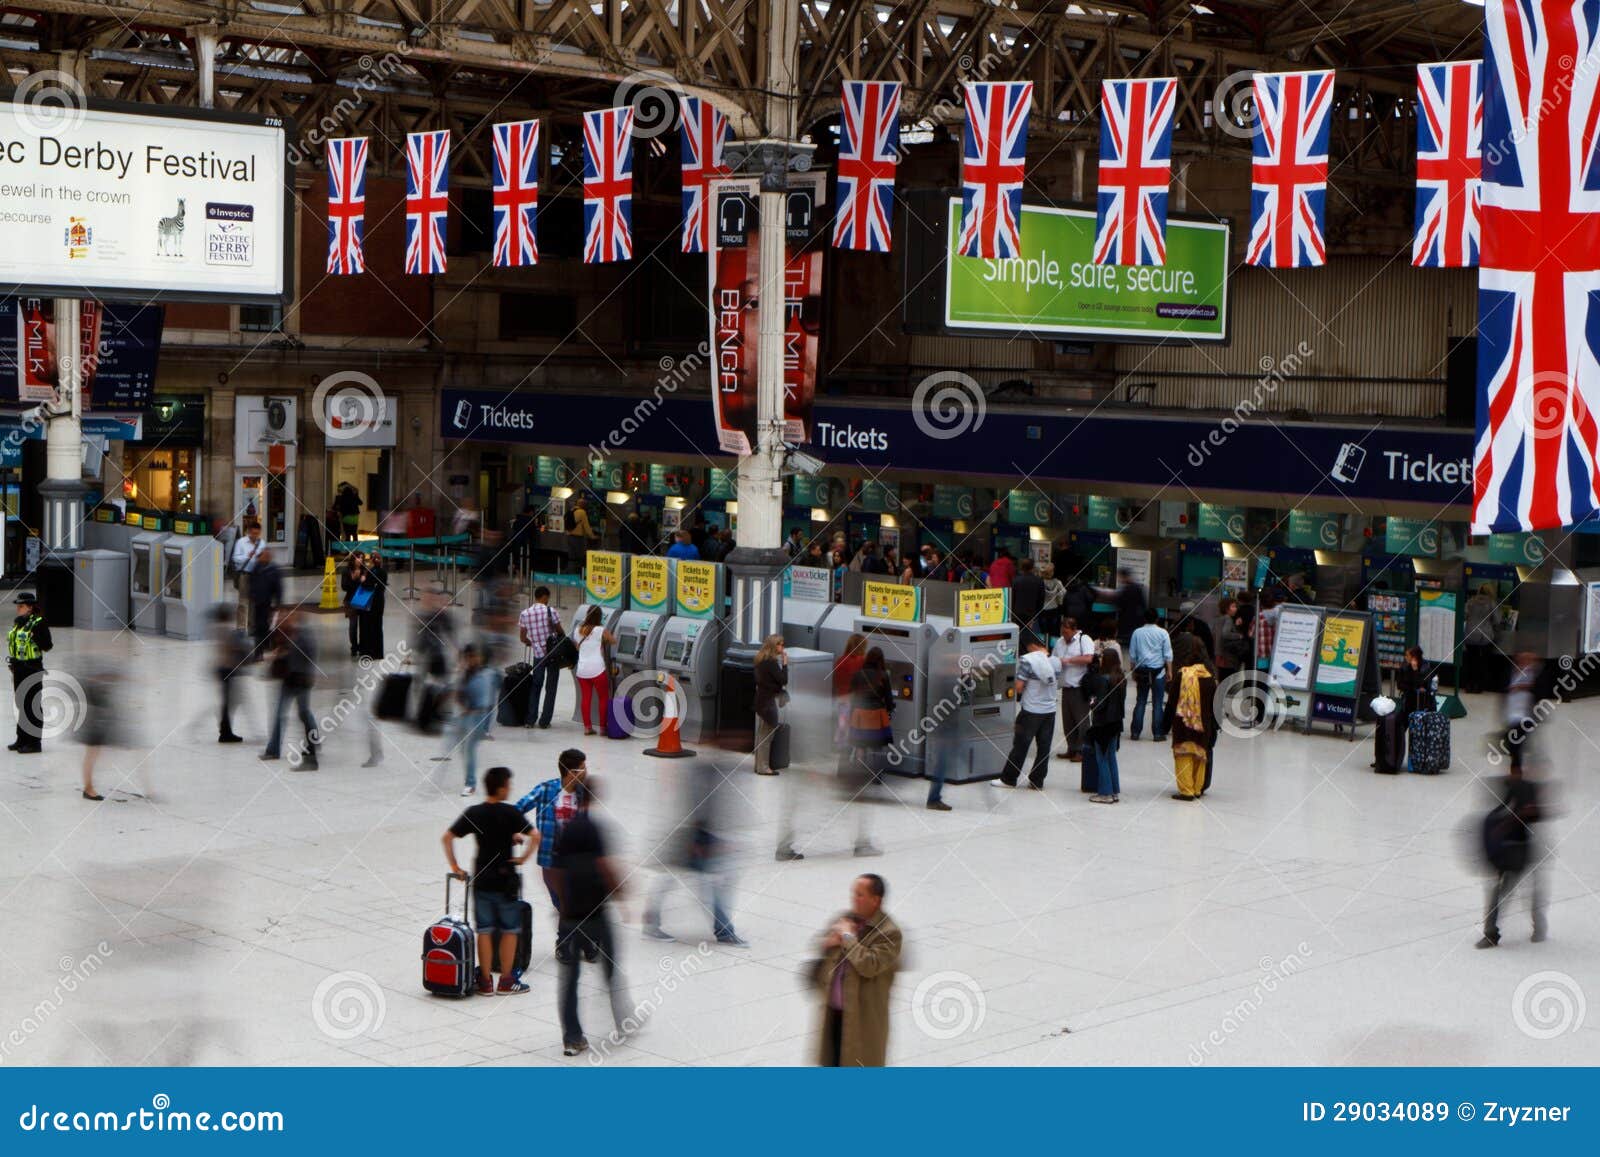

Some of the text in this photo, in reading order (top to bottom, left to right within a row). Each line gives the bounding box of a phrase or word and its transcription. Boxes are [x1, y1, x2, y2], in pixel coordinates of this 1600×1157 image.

[40, 136, 133, 179] Derby
[146, 145, 256, 182] Festival
[1, 184, 131, 205] ewel in the crown
[216, 208, 250, 218] Investec
[209, 234, 249, 243] INVESTEC
[209, 242, 249, 253] DERBY
[785, 262, 805, 319] THE
[1127, 265, 1198, 295] secure.
[28, 320, 45, 373] MILK
[720, 289, 740, 393] BENGA
[480, 405, 534, 429] Tickets
[817, 423, 888, 450] Tickets
[1384, 451, 1473, 484] Ticket
[682, 565, 701, 575] Tickets
